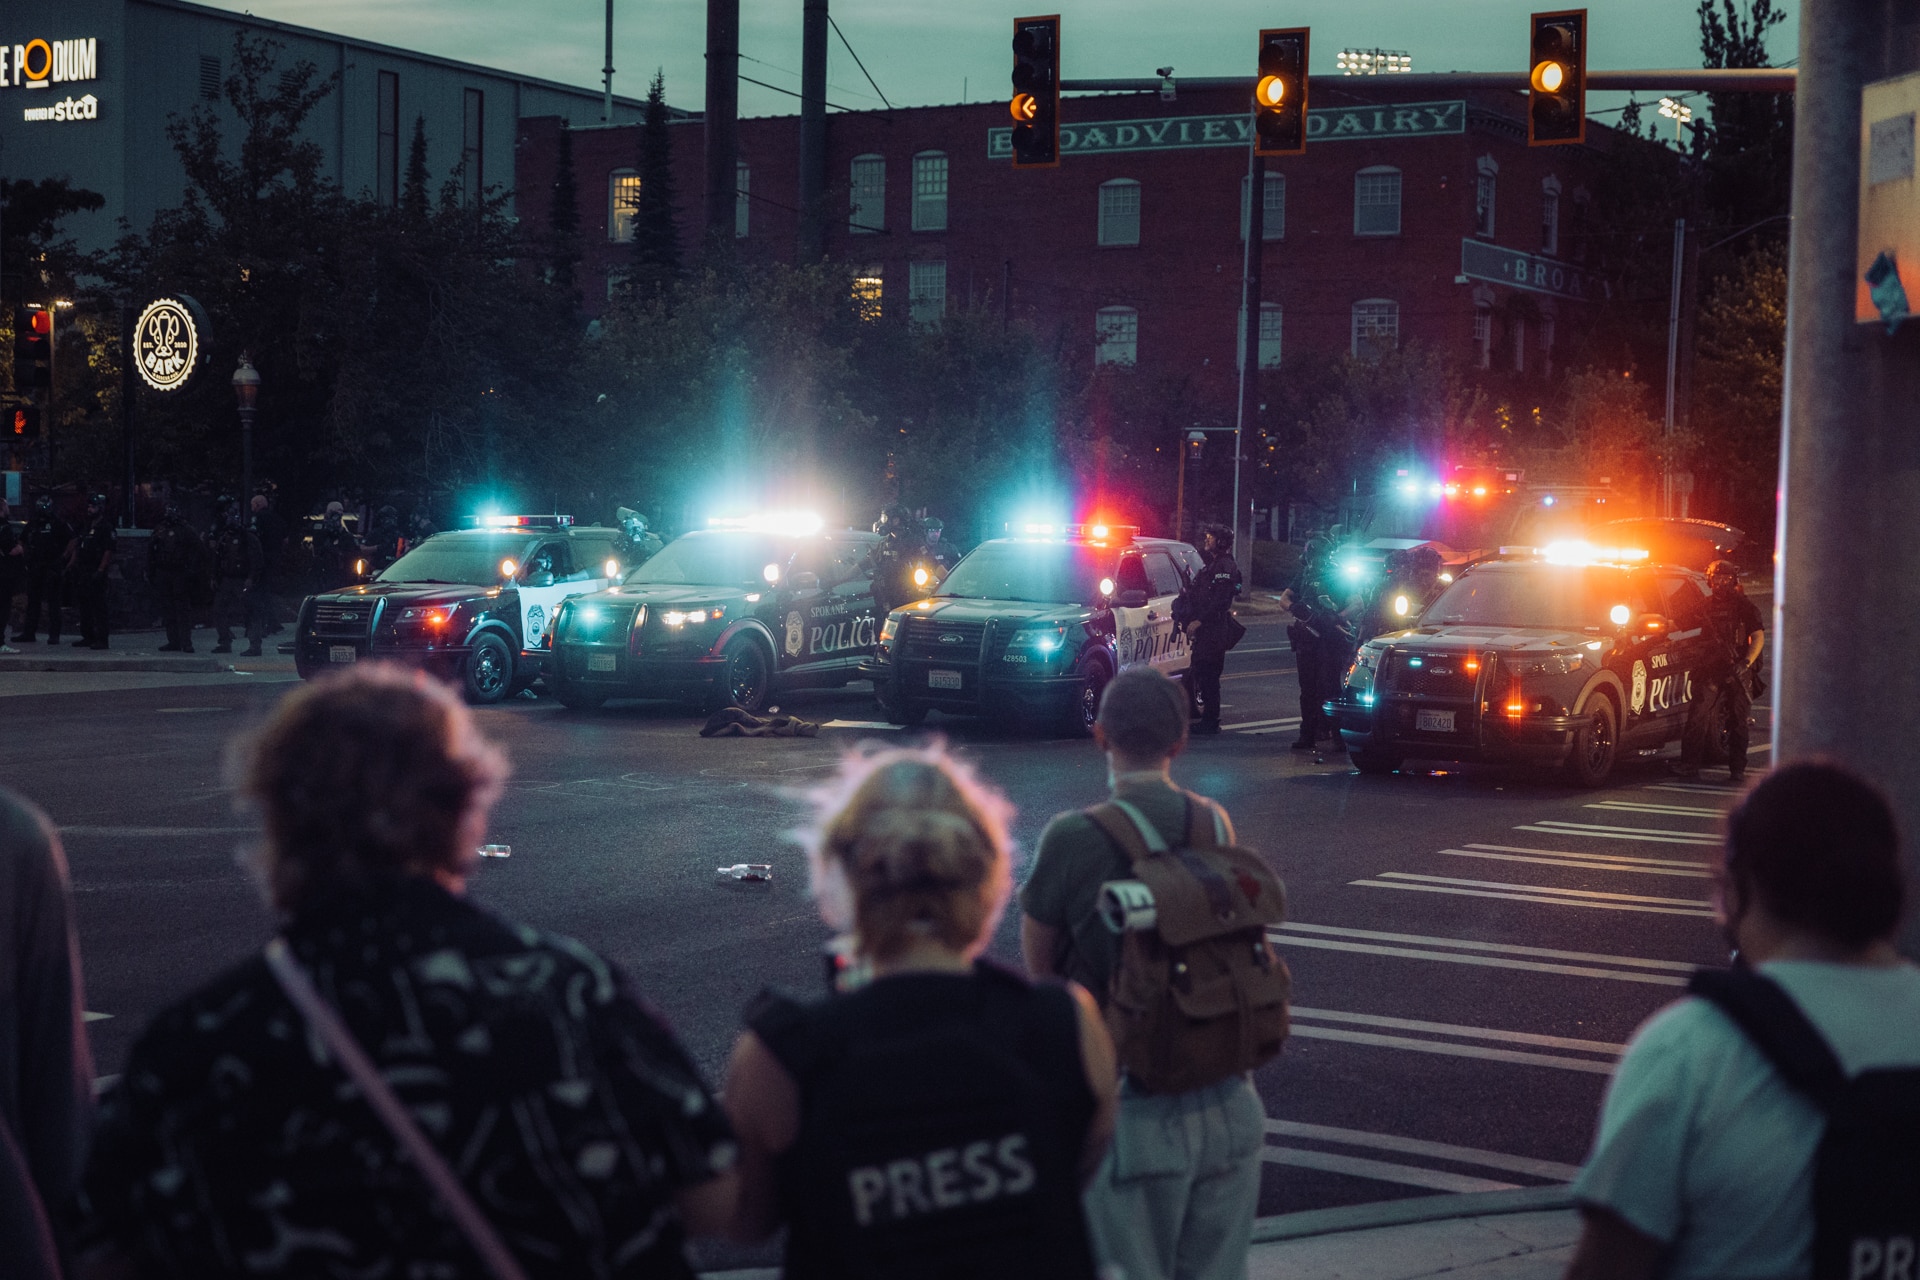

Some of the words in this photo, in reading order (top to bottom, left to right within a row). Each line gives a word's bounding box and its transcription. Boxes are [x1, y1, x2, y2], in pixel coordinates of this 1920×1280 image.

[14, 38, 96, 87] PODIUM
[55, 94, 98, 121] stcu
[992, 118, 1252, 153] BOADVIE
[1306, 104, 1460, 136] DAIRY
[145, 350, 185, 376] BARK
[811, 603, 847, 618] SPOKANE
[1002, 654, 1027, 663] 428503
[849, 1132, 1037, 1226] PRESS
